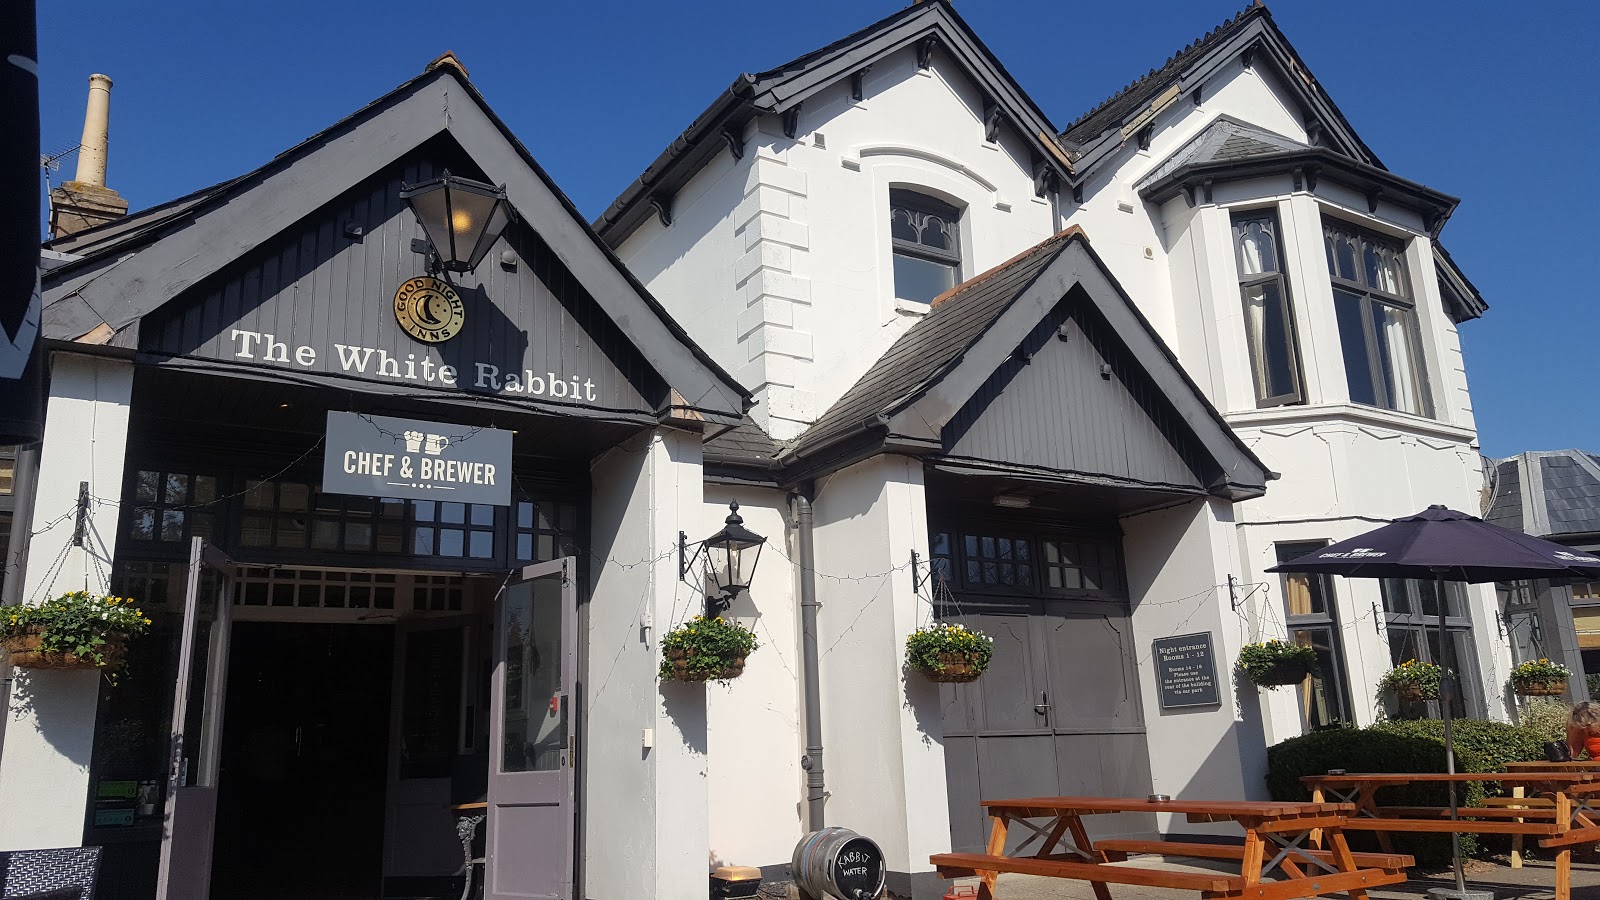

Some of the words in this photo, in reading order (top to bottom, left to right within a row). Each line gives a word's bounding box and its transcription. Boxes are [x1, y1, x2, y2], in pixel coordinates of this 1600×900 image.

[397, 279, 425, 312] GOOD
[431, 279, 463, 319] NIGHT
[408, 324, 451, 341] INNS
[231, 329, 316, 367] The
[334, 343, 458, 385] White
[474, 362, 597, 402] Rabbit
[343, 450, 395, 478] CHEF
[400, 455, 414, 480] &
[420, 457, 496, 486] BREWER
[1179, 644, 1206, 652] entrance
[842, 866, 868, 876] WATER
